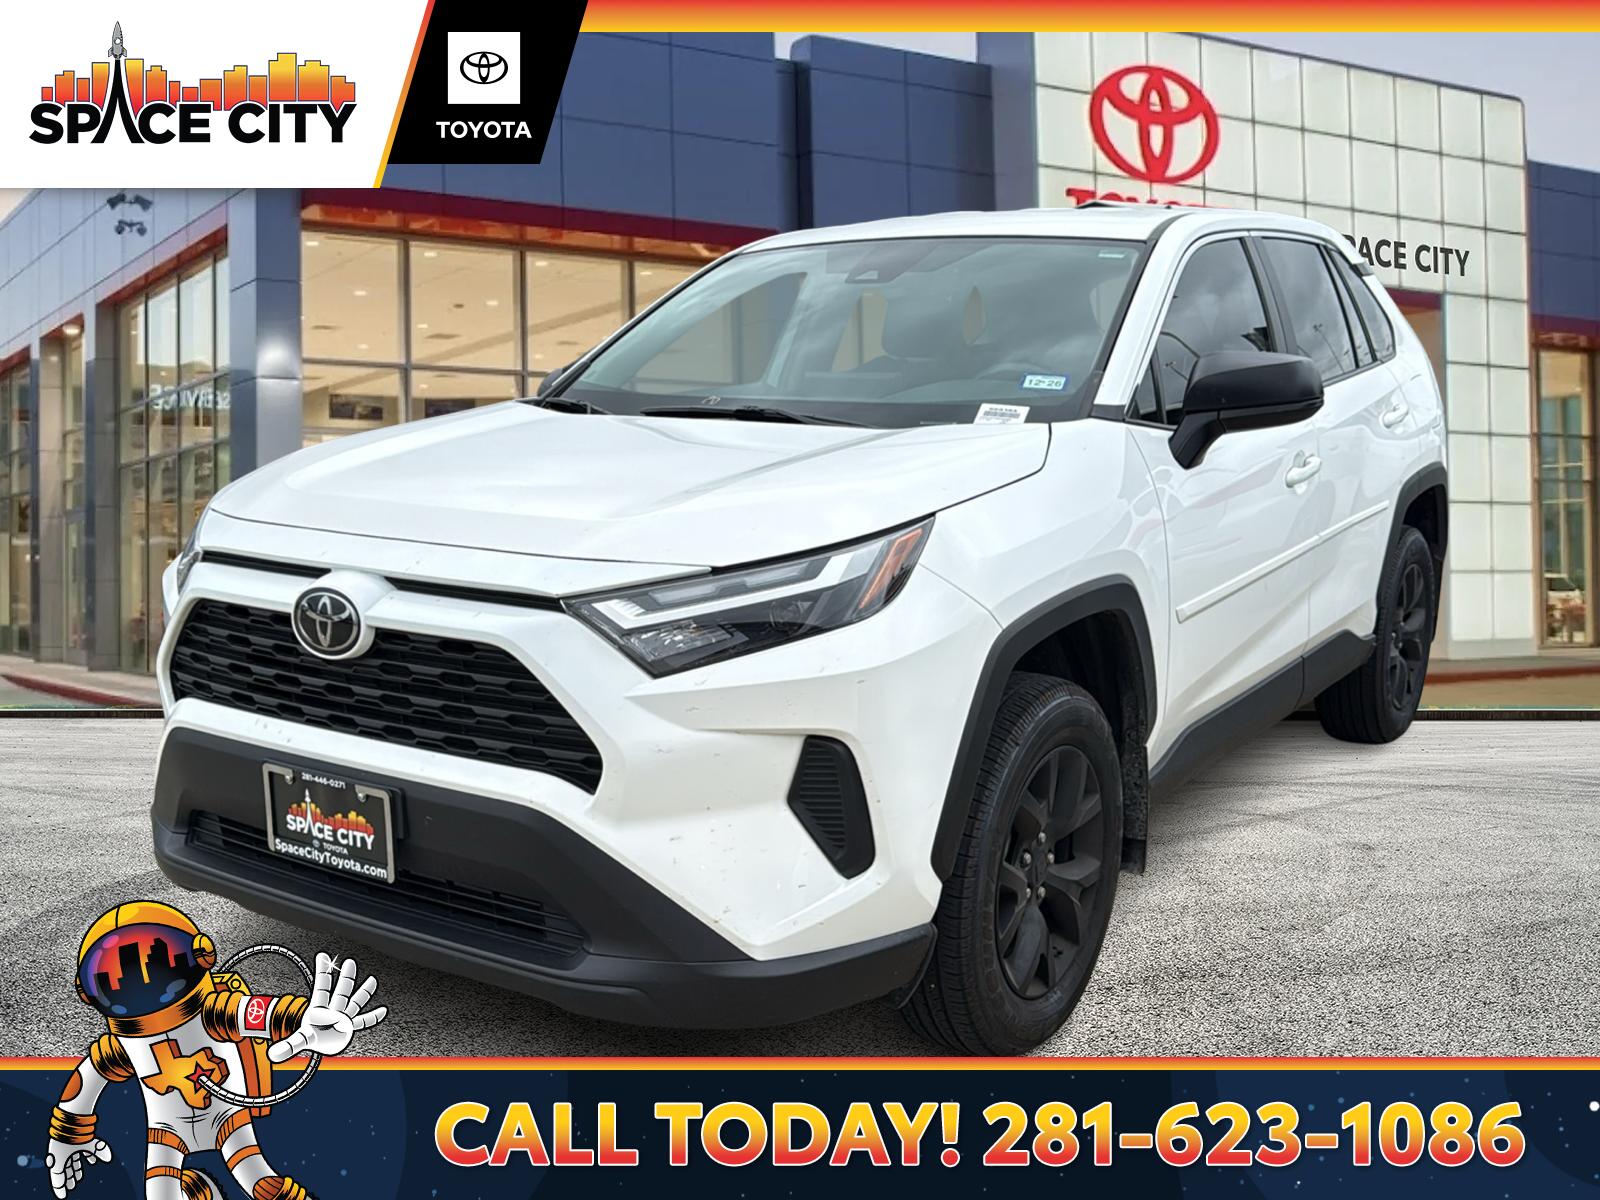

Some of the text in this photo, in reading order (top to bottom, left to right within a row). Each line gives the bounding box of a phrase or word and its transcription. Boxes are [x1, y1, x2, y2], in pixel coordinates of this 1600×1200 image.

[1414, 244, 1470, 277] CITY
[286, 800, 375, 850] SPACE CITY
[275, 838, 388, 879] SpaceCityToyota.com
[322, 842, 349, 855] TOYOTA
